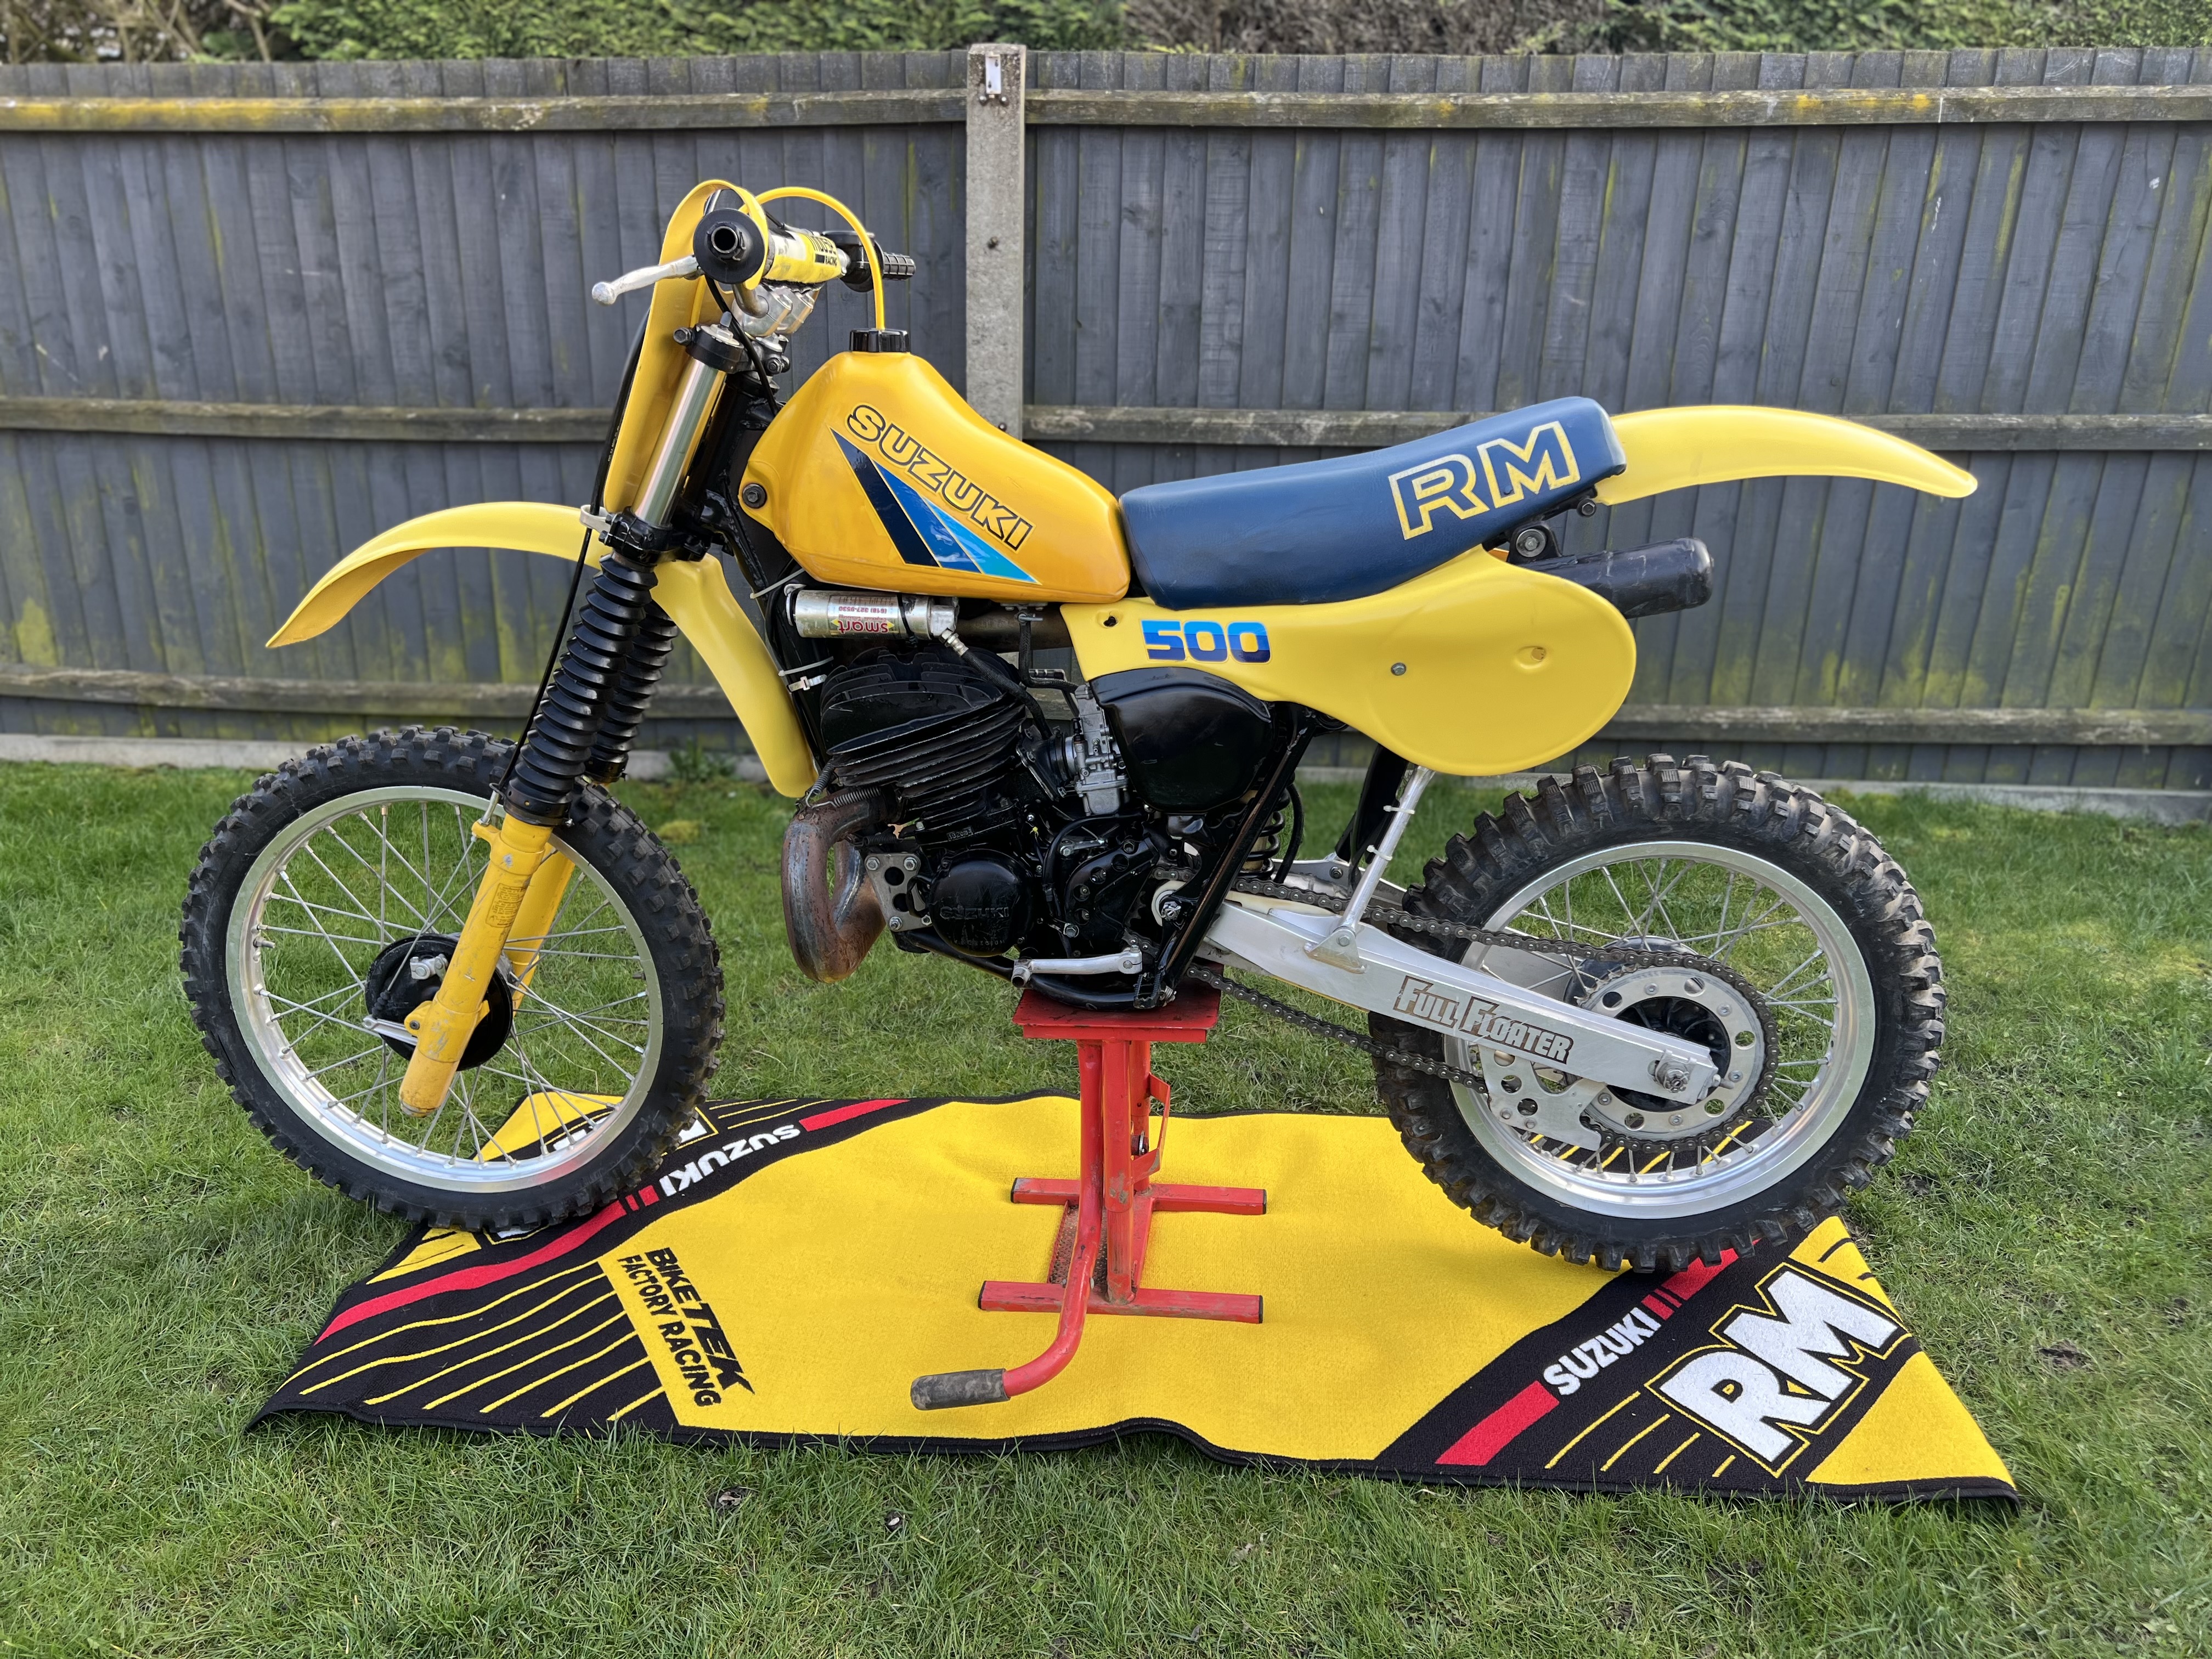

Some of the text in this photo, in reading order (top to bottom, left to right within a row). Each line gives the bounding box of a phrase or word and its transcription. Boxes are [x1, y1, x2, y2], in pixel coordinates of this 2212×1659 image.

[847, 404, 1033, 551] SUZUKI
[1388, 421, 1581, 540] RM
[837, 620, 888, 634] smart
[1141, 619, 1271, 663] 500
[939, 906, 1010, 920] SUZUKI
[659, 1124, 801, 1197] SUZUKI
[617, 1254, 722, 1407] FACTORY RACING
[1543, 1307, 1662, 1396] SUZUKI
[1658, 1269, 1899, 1463] RM
